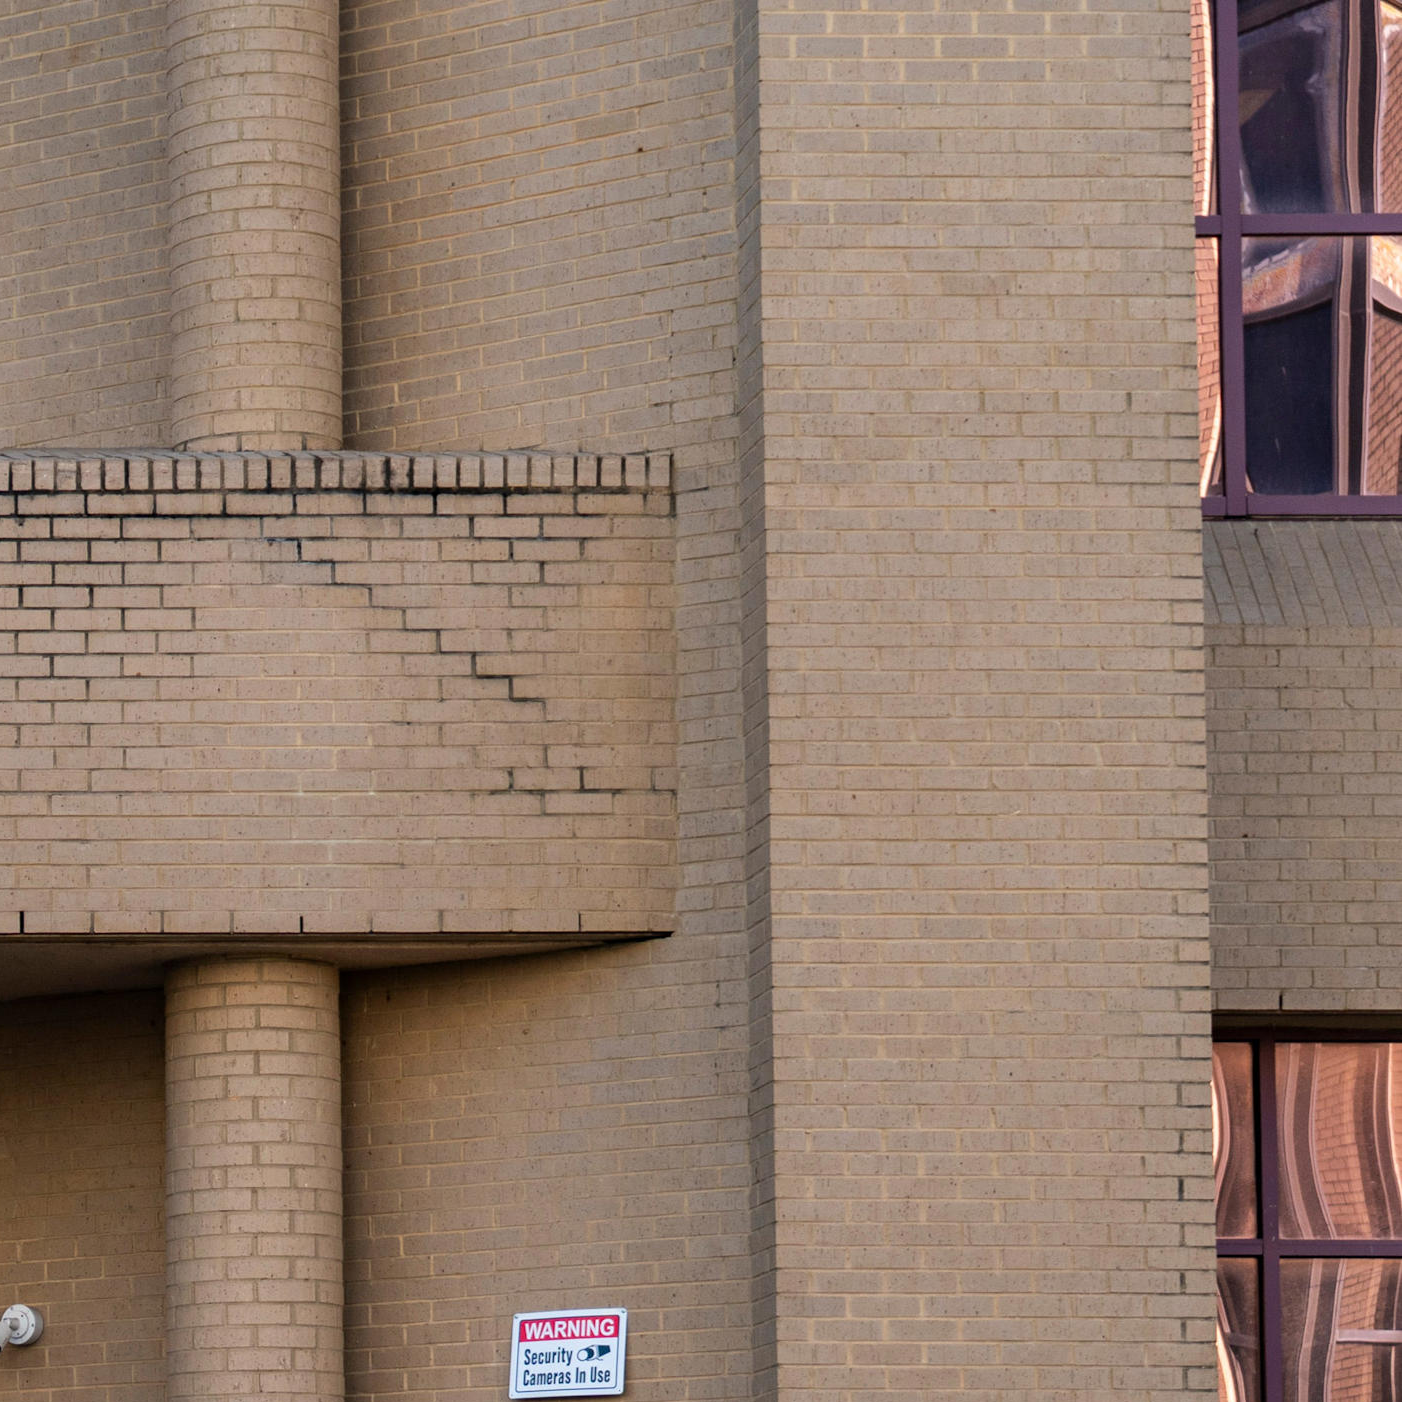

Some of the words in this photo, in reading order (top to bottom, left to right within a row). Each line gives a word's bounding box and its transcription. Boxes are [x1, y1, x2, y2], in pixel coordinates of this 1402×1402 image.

[524, 1318, 615, 1340] WARNING
[523, 1346, 573, 1366] Security
[522, 1369, 572, 1387] Cameras
[575, 1367, 586, 1384] In
[590, 1366, 611, 1383] Use
